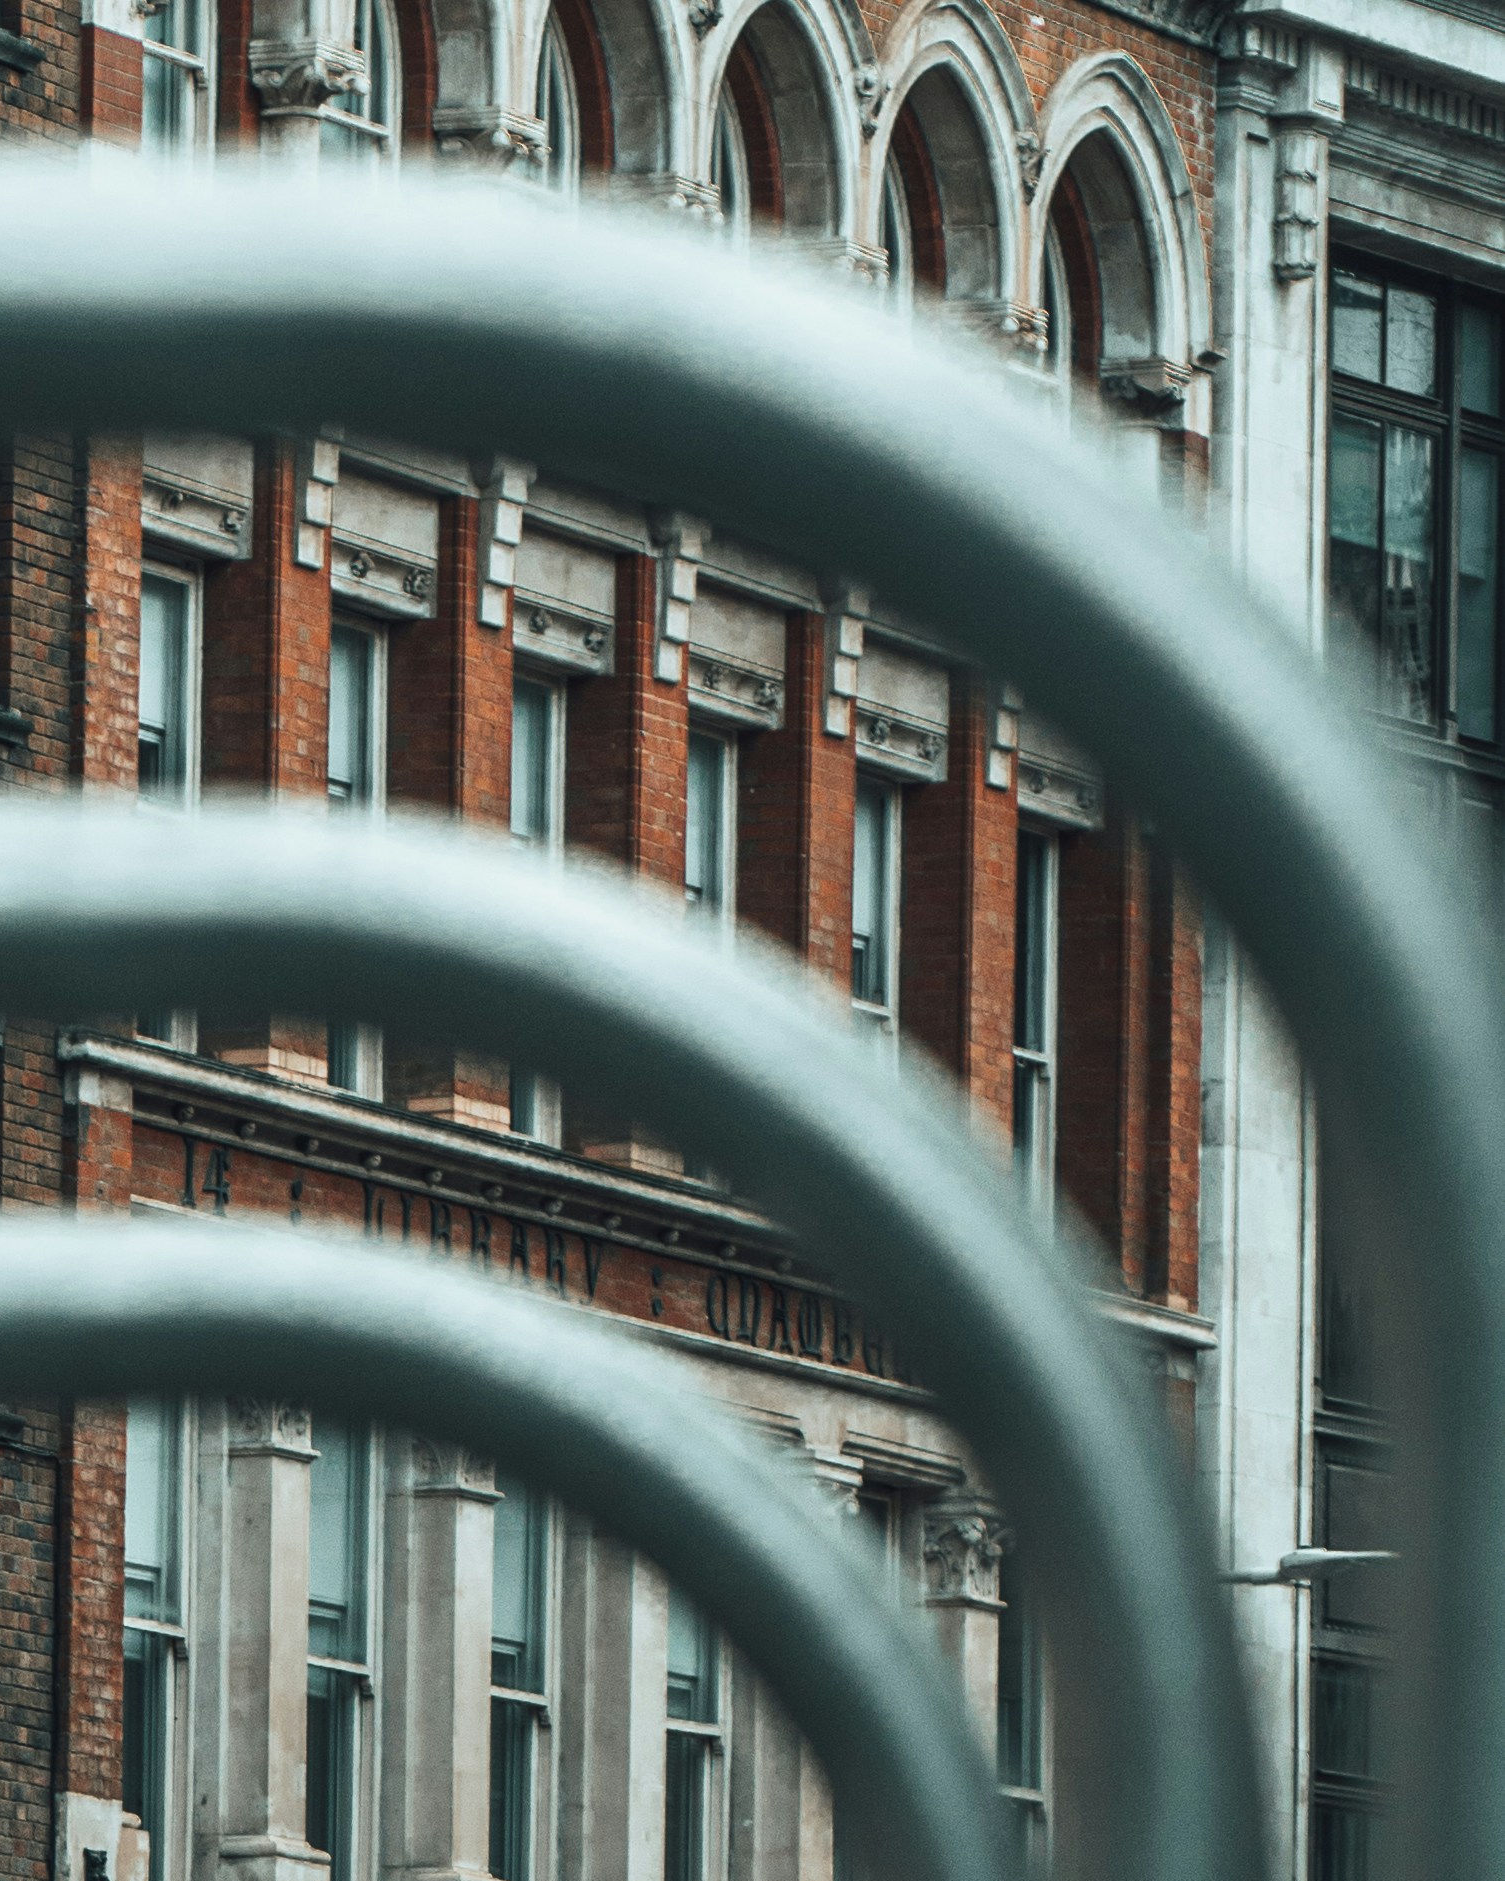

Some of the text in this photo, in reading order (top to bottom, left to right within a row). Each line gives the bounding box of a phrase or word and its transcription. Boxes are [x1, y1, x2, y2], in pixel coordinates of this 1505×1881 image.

[180, 1134, 232, 1217] 14
[361, 1182, 604, 1306] LIBRARY
[705, 1271, 912, 1385] CHAMBE
